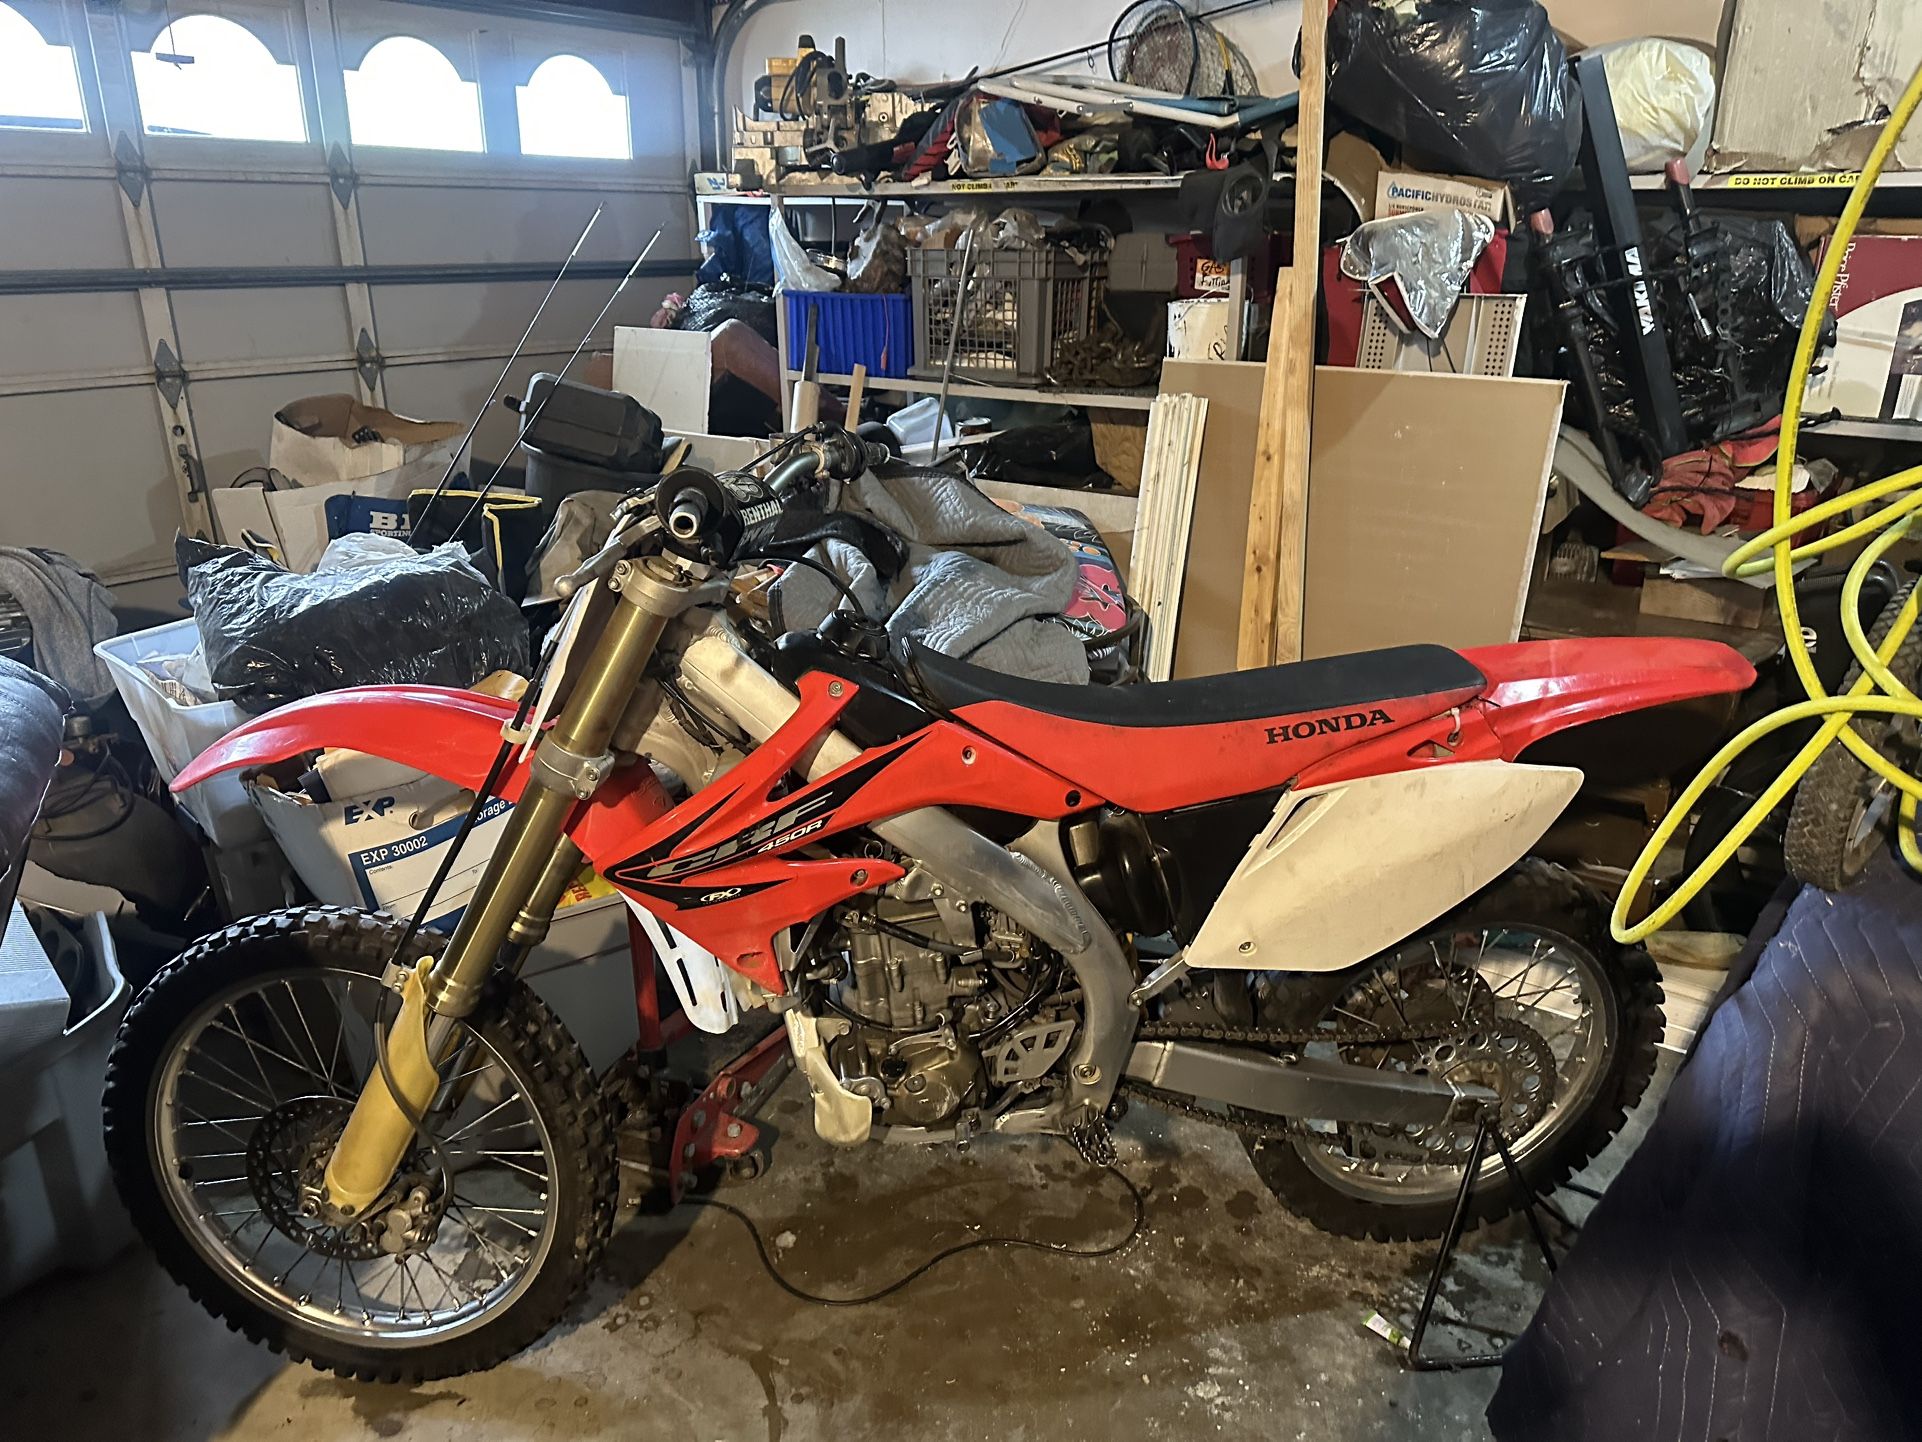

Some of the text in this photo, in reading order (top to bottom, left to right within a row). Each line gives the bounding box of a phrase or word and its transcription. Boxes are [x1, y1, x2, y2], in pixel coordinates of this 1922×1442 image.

[1780, 177, 1815, 185] CLIMB
[1819, 176, 1835, 184] ON
[740, 499, 783, 526] RENTHAL
[1264, 709, 1395, 744] HONDA
[360, 835, 429, 866] EXP 30002
[647, 791, 834, 878] CRF
[757, 819, 824, 854] 450R
